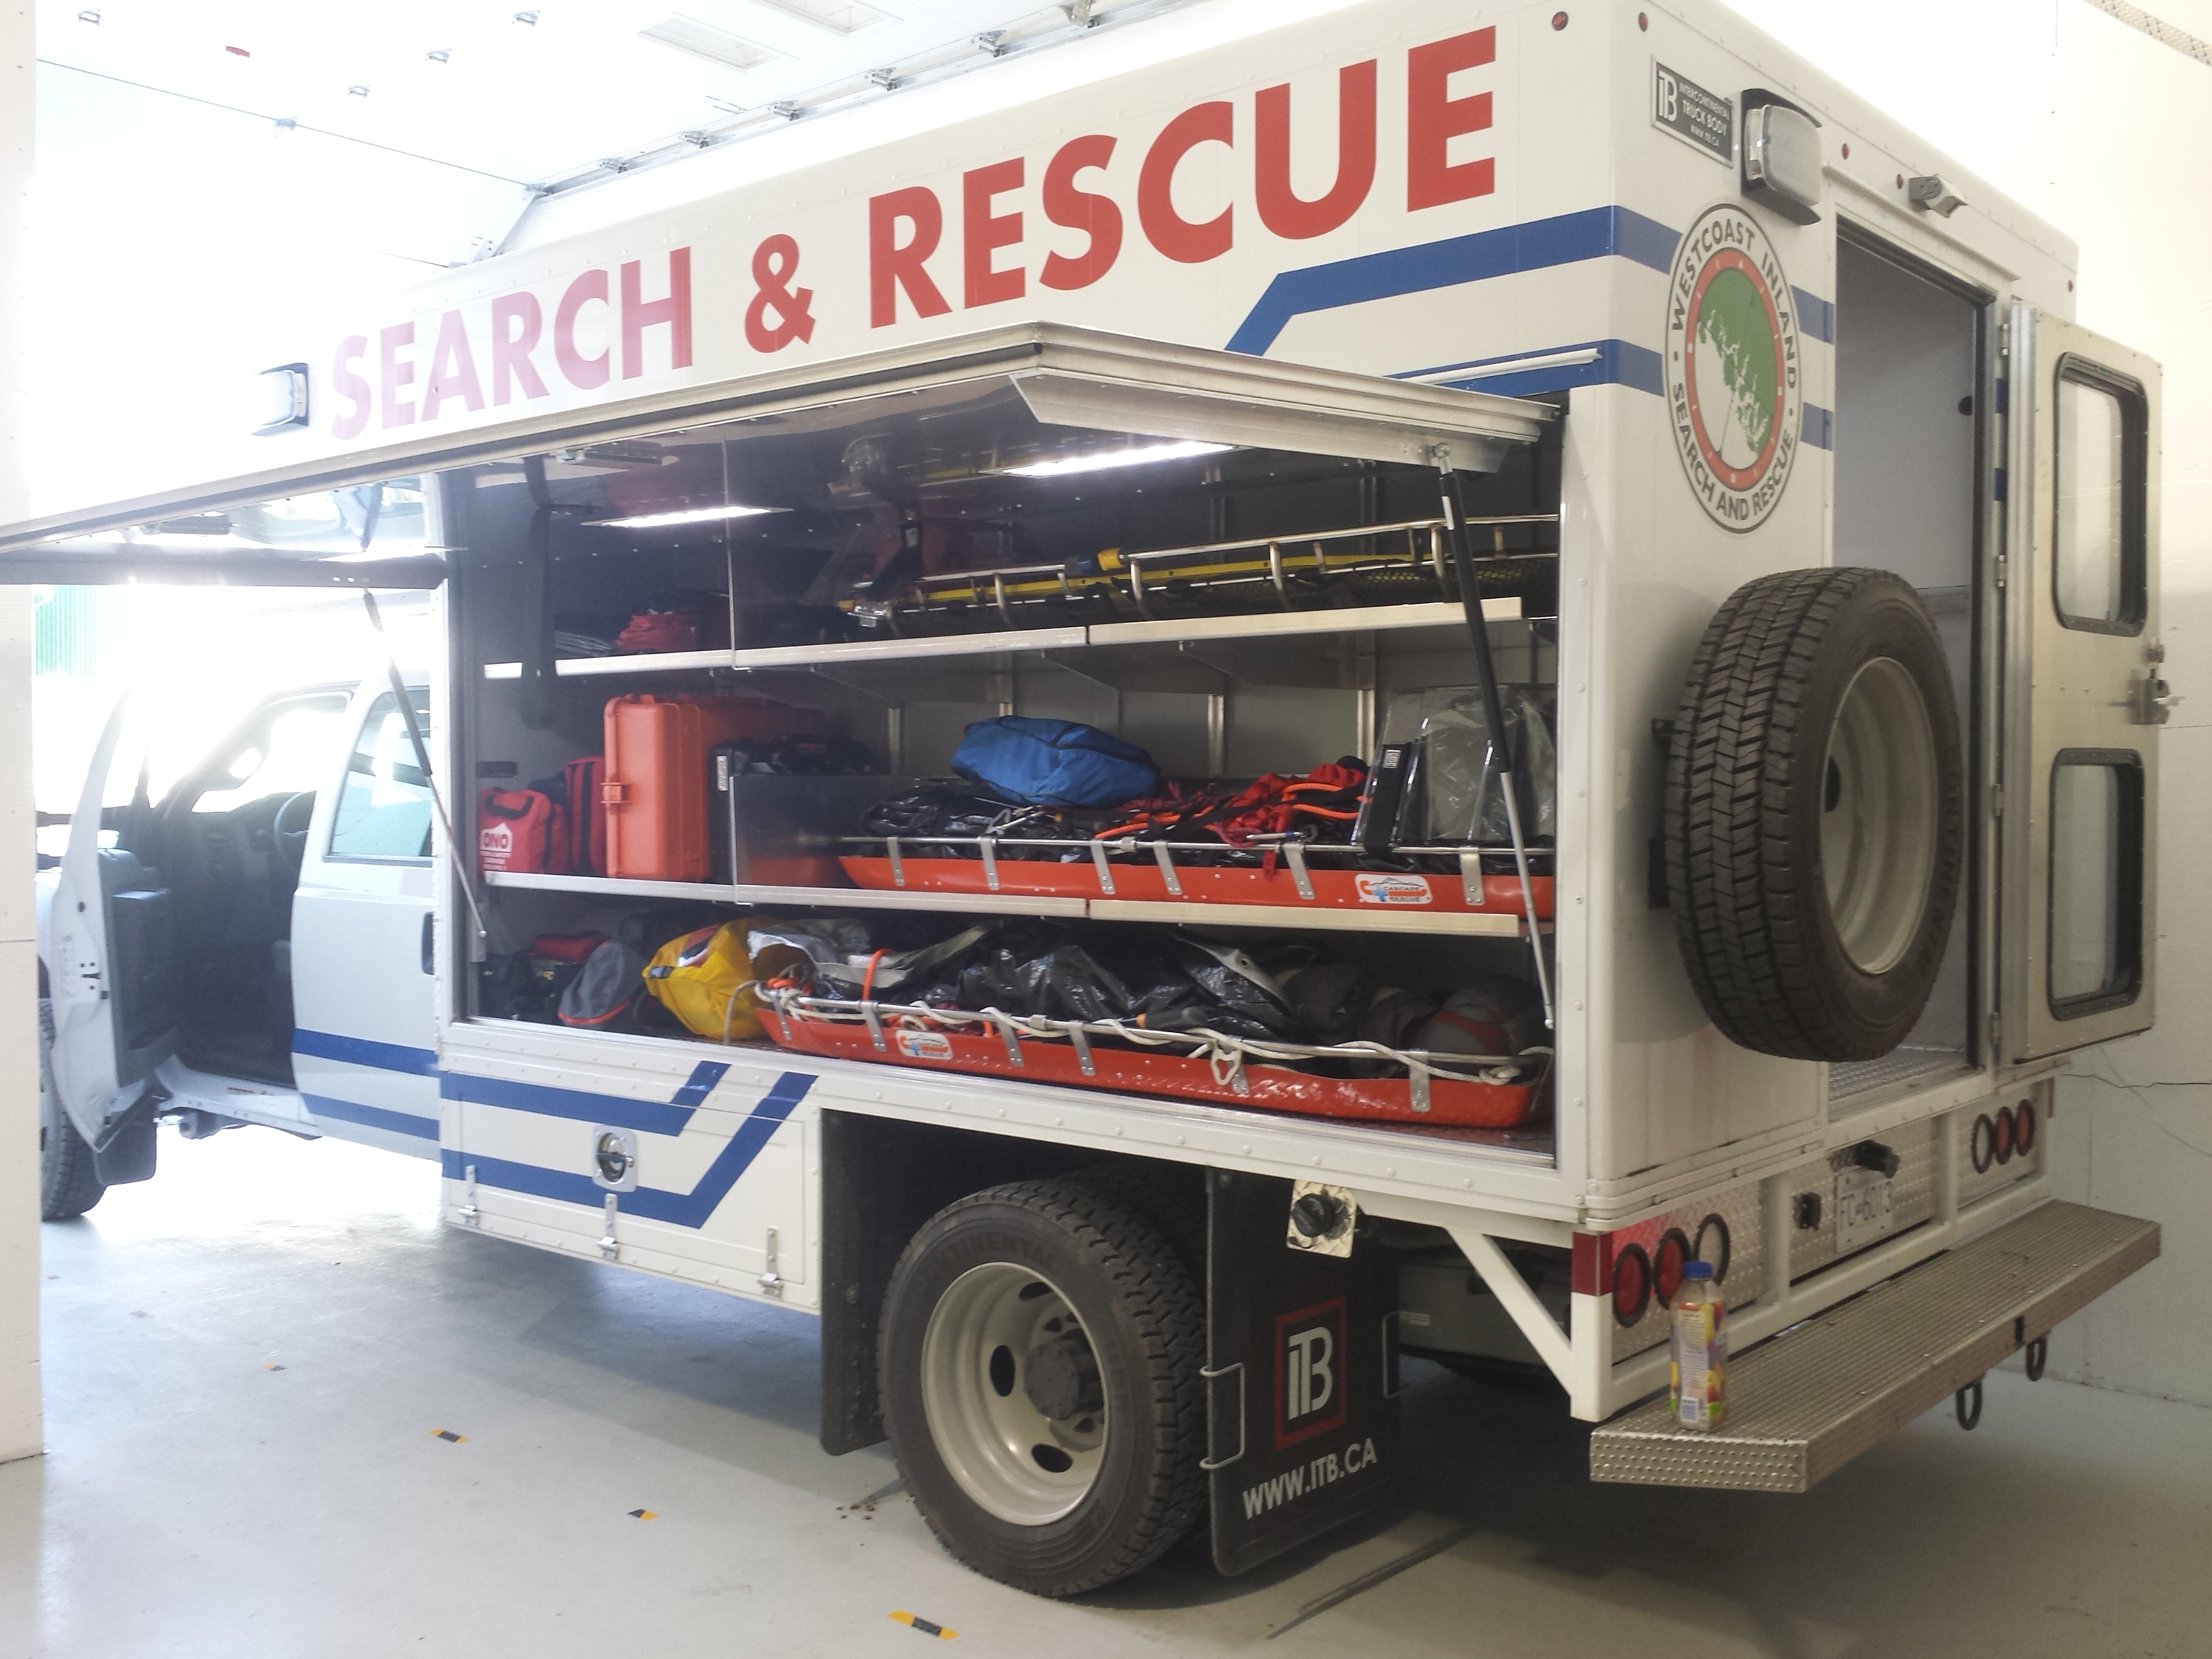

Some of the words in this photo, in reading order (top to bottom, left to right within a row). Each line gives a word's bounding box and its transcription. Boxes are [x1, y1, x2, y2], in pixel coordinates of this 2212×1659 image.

[1682, 100, 1706, 125] TRUCK
[1707, 114, 1727, 136] BODY
[331, 246, 693, 439] SEARCH
[745, 234, 816, 353] &
[869, 25, 1496, 329] RESCUE
[1672, 218, 1756, 331] WESTCOAST
[1761, 251, 1797, 389] INLAND
[1673, 383, 1715, 502] SEARCH
[1716, 497, 1748, 521] AND
[1753, 428, 1793, 512] RESCUE
[1242, 1437, 1378, 1520] WWW.ITB.CA
